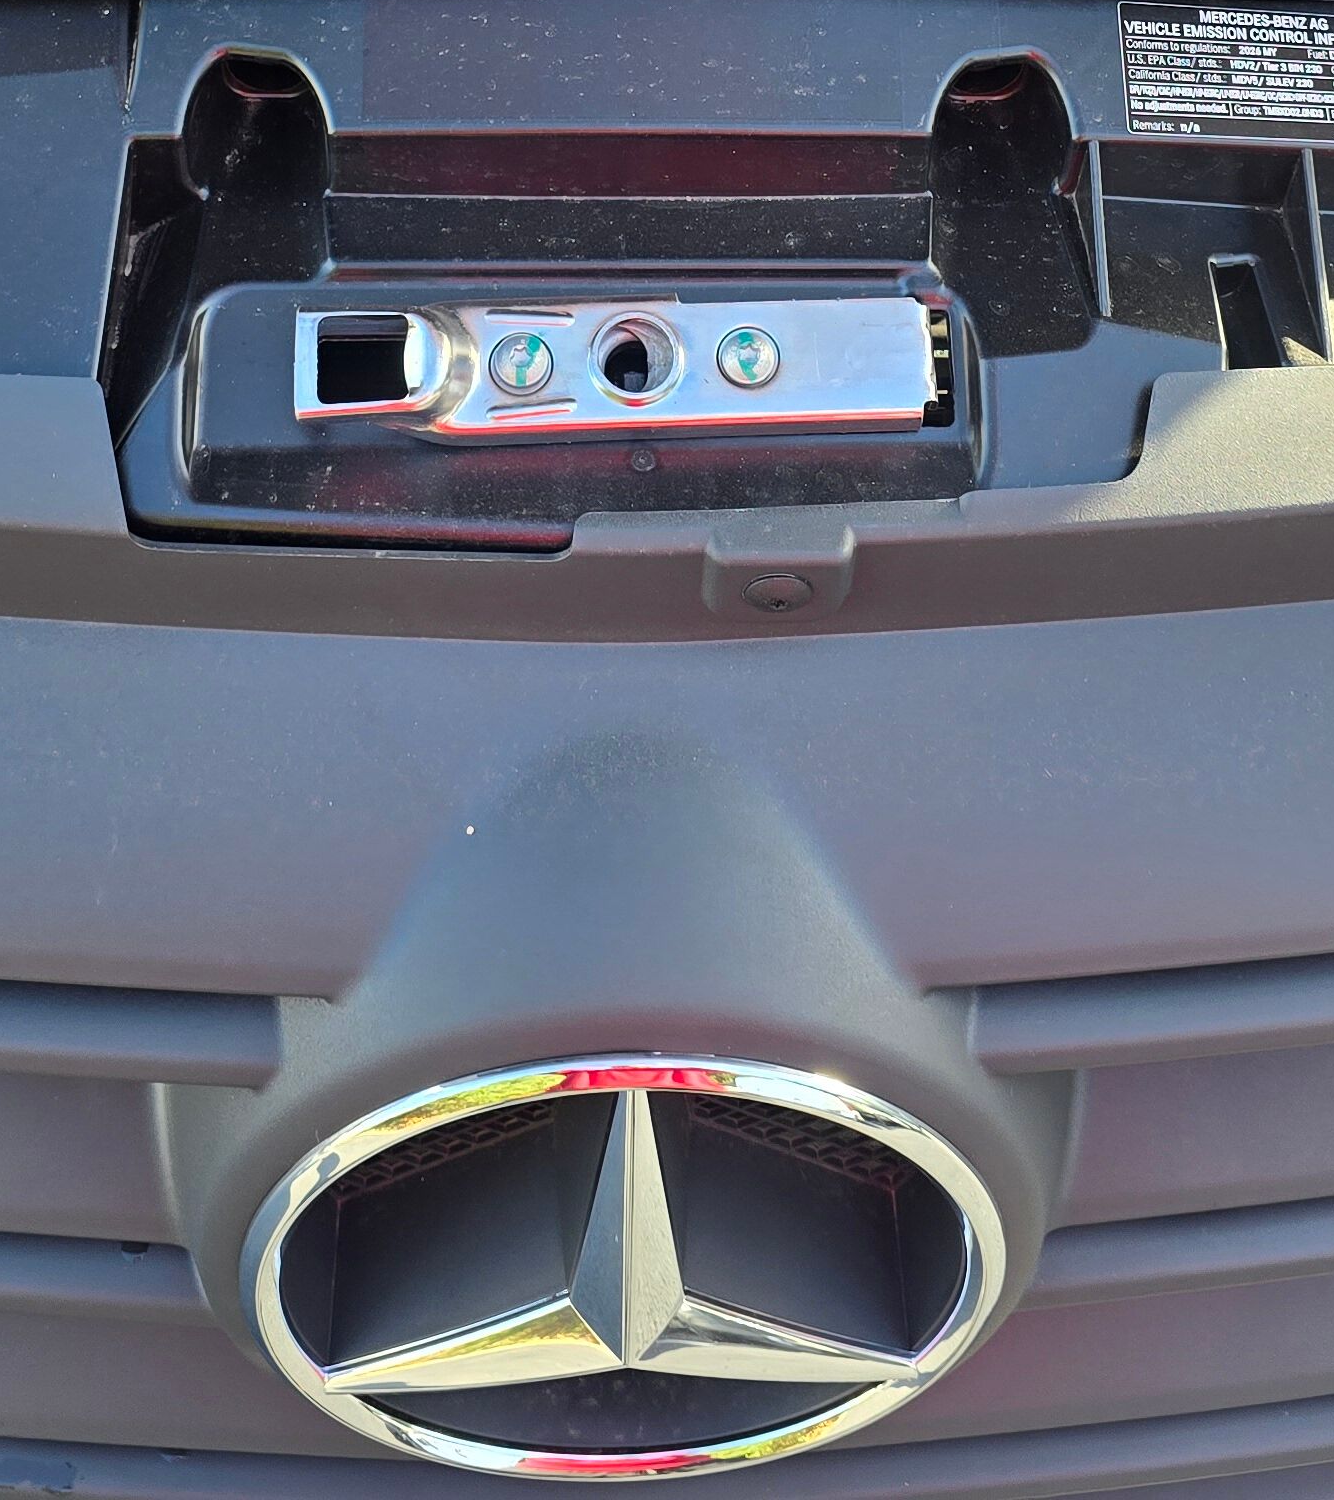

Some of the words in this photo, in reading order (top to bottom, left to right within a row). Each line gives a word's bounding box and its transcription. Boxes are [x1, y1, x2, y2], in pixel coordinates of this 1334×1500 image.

[1199, 9, 1308, 30] MERCEDES-BENZ
[1310, 17, 1329, 31] AG
[1124, 20, 1181, 37] VEHICLE
[1183, 24, 1247, 40] EMISSION
[1249, 28, 1313, 45] CONTROL
[1126, 39, 1168, 51] Conforms
[1170, 41, 1180, 52] to
[1181, 43, 1231, 54] regulations:
[1307, 48, 1328, 60] Fuel:
[1127, 54, 1147, 65] U.S.
[1148, 55, 1166, 65] EPA
[1280, 63, 1287, 72] 3
[1128, 68, 1170, 80] California
[1234, 104, 1262, 116] Group:
[1133, 120, 1175, 132] Remarks:
